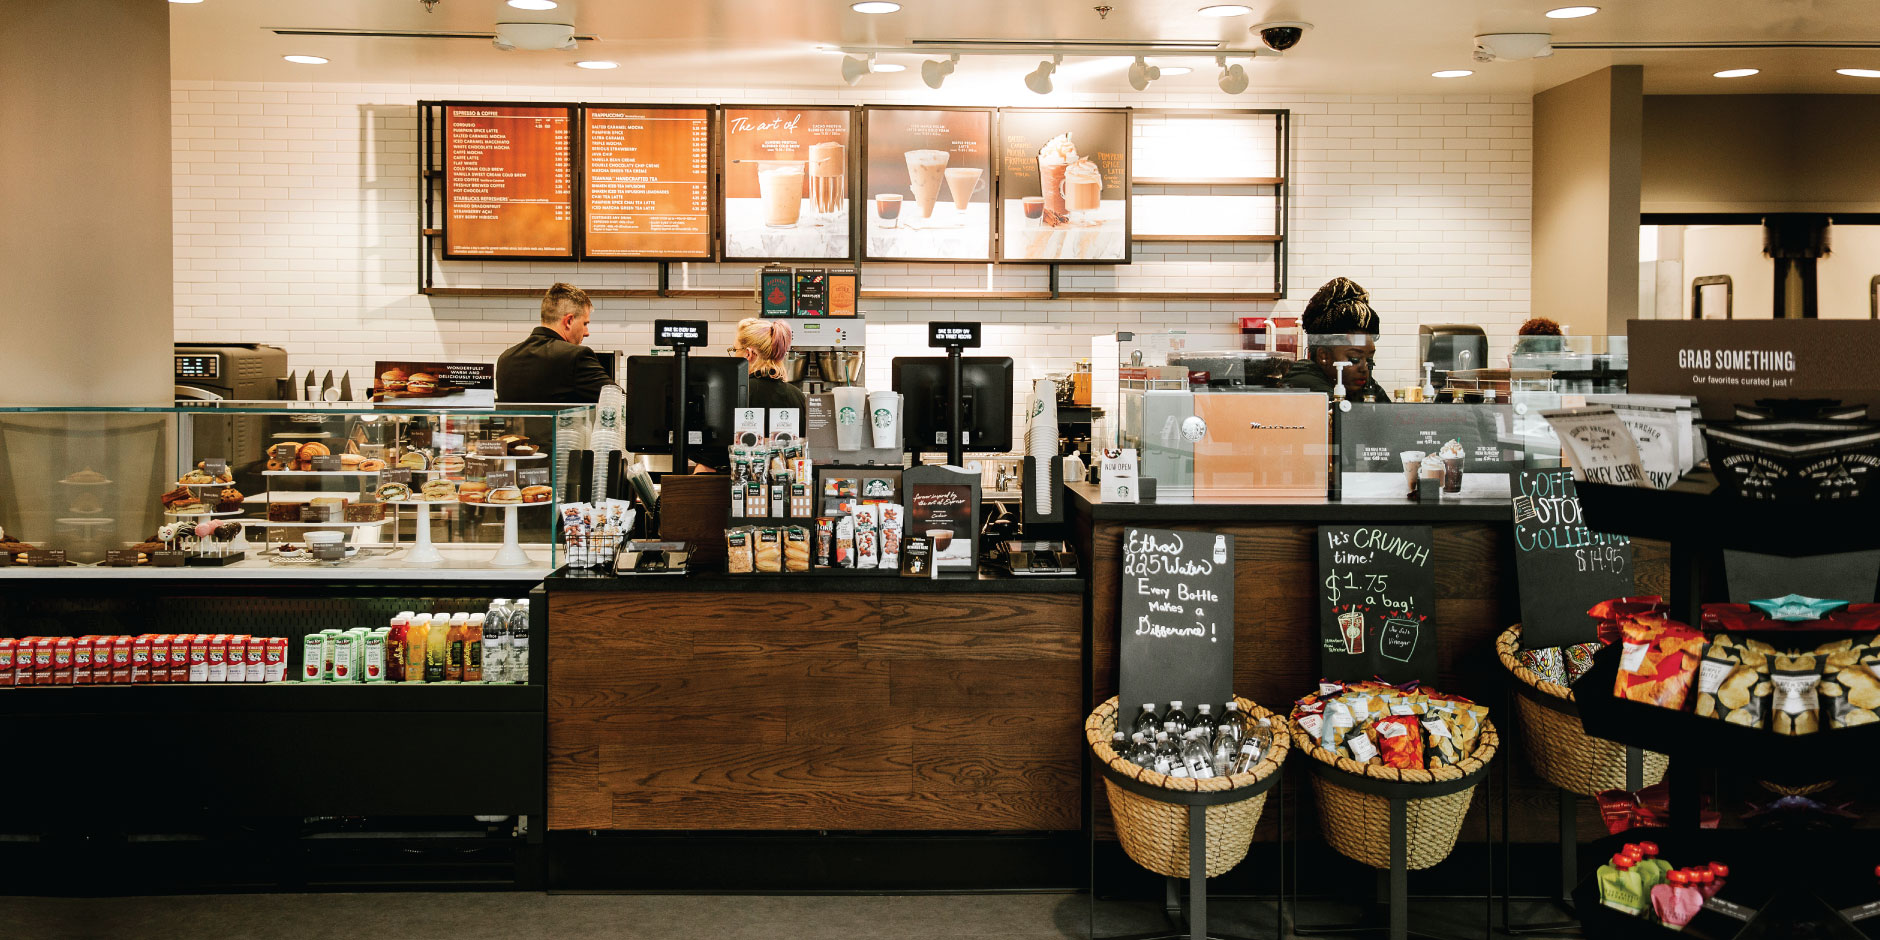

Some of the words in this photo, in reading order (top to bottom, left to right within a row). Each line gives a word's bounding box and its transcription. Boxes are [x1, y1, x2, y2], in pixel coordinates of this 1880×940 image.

[731, 117, 755, 134] The
[757, 116, 782, 130] art
[784, 114, 800, 134] of
[1679, 349, 1711, 369] GRAB
[1715, 350, 1794, 371] SOMETHING
[1692, 375, 1706, 384] Our
[1708, 375, 1739, 385] favorites
[1741, 377, 1770, 386] curated
[1772, 378, 1787, 388] just
[1634, 422, 1661, 439] ARCHER
[1723, 453, 1755, 467] COUNTRY
[1758, 457, 1788, 477] ARCHER
[1129, 529, 1183, 555] Ethos
[1328, 531, 1349, 549] It's
[1354, 528, 1430, 567] CRUNCH
[1161, 556, 1212, 576] Water
[1334, 551, 1374, 564] time!
[1575, 546, 1624, 574] $14.95
[1138, 578, 1170, 599] Every
[1178, 583, 1218, 602] Bottle
[1326, 568, 1388, 606] $1.75
[1148, 601, 1183, 614] Makes
[1195, 608, 1204, 616] a
[1366, 596, 1376, 605] a
[1382, 594, 1414, 613] bag!
